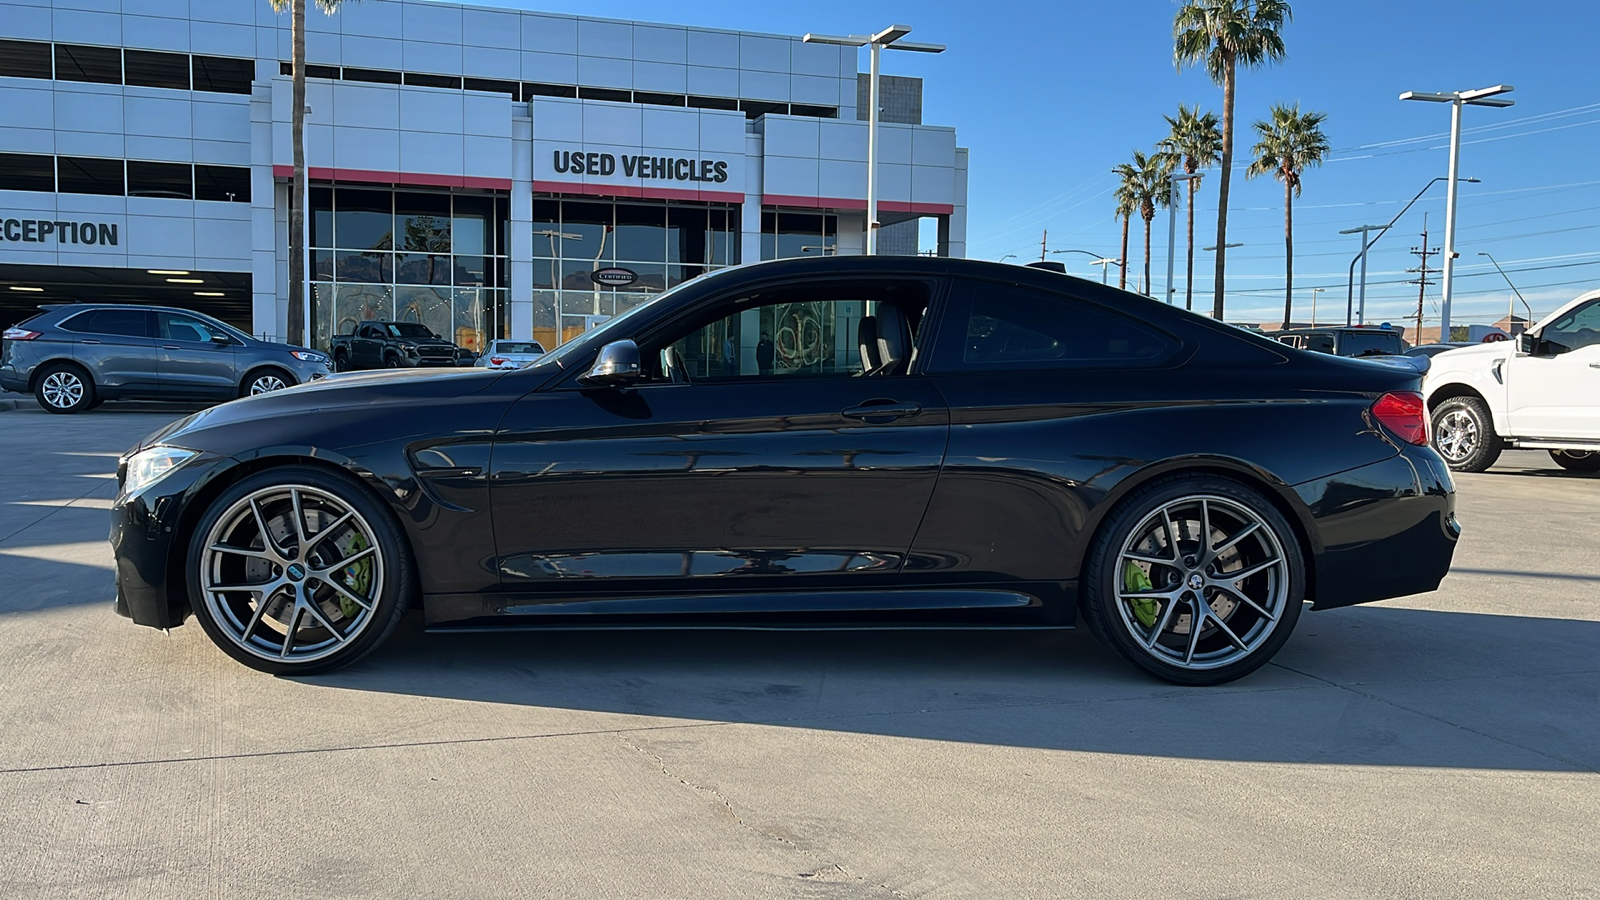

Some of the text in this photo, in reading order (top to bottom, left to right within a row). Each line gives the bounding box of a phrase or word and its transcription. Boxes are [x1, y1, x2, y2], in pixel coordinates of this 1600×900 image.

[553, 150, 728, 183] USED VEHICLES
[0, 218, 118, 246] CEPTION
